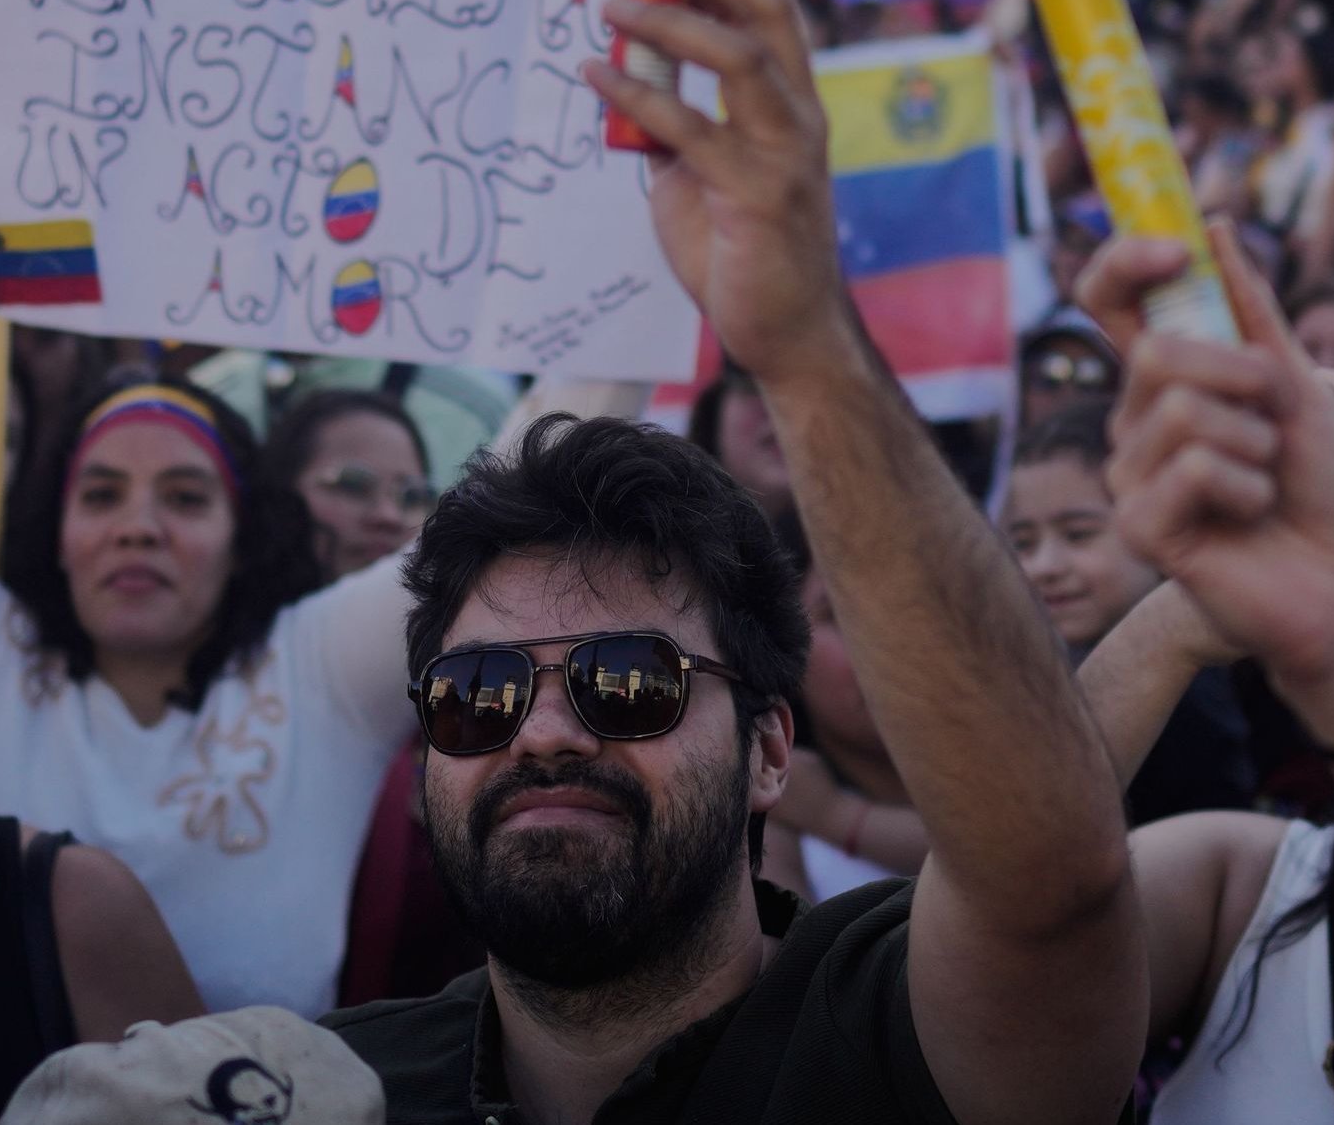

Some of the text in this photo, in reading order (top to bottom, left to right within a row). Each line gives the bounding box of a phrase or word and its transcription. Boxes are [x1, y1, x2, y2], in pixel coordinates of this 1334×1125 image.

[16, 123, 556, 287] UN ACTO DE
[166, 247, 472, 354] AMOR
